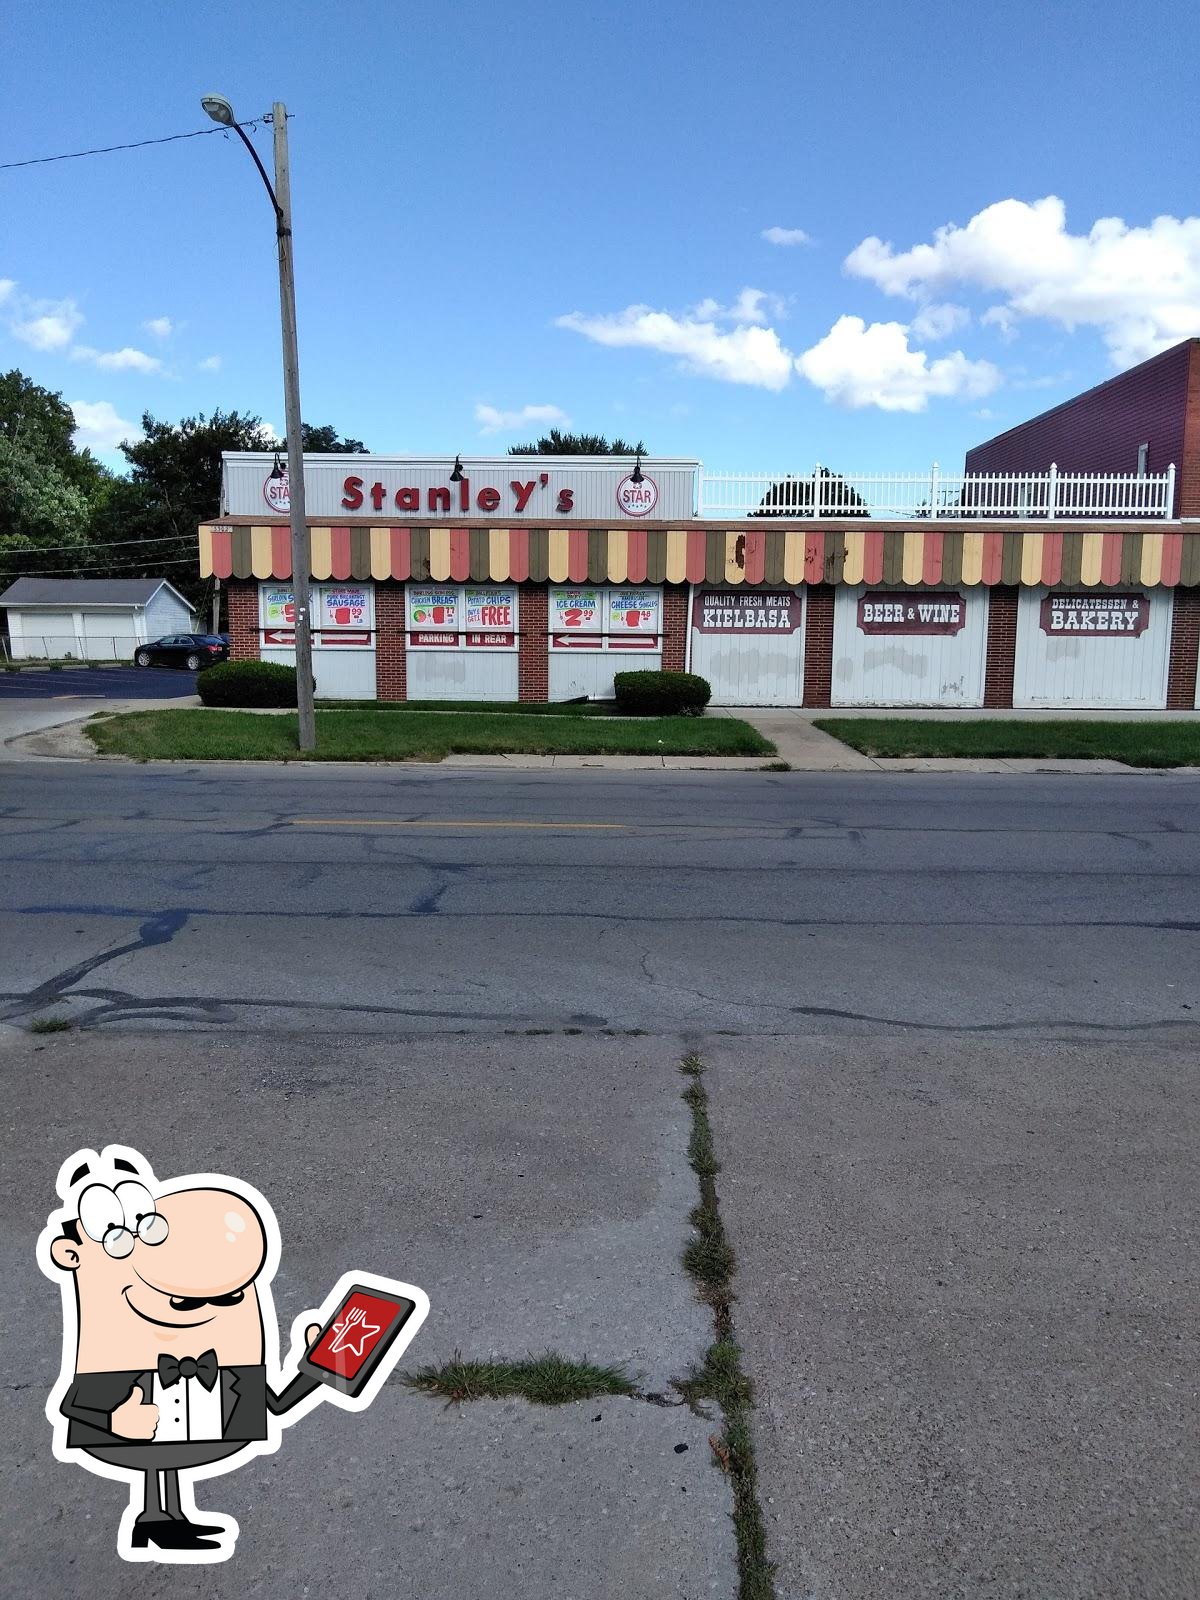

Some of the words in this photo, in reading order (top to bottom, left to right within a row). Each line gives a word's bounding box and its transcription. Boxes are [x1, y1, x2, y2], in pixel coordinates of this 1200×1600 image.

[270, 486, 290, 500] STA
[341, 474, 574, 511] Stanley's
[623, 490, 651, 503] STAR
[326, 599, 366, 607] SAUSAGE
[431, 596, 458, 604] BREAST
[468, 597, 485, 605] POTATO
[486, 596, 511, 605] CHIPS
[556, 600, 568, 608] ICE
[569, 600, 596, 608] CREAM
[611, 600, 637, 609] CHEESE
[704, 596, 735, 606] QUALITY
[739, 596, 762, 607] FRESH
[766, 596, 791, 607] MEATS
[1052, 598, 1127, 610] DELICATESSEN
[1132, 599, 1139, 609] &
[481, 606, 511, 625] FREE
[703, 609, 791, 628] KIELBASA
[863, 603, 904, 622] BEER
[907, 607, 915, 620] &
[917, 604, 960, 623] WINE
[1051, 611, 1139, 630] BAKERY
[418, 634, 454, 643] PARKING
[471, 634, 480, 643] IN
[484, 635, 507, 643] REAR
